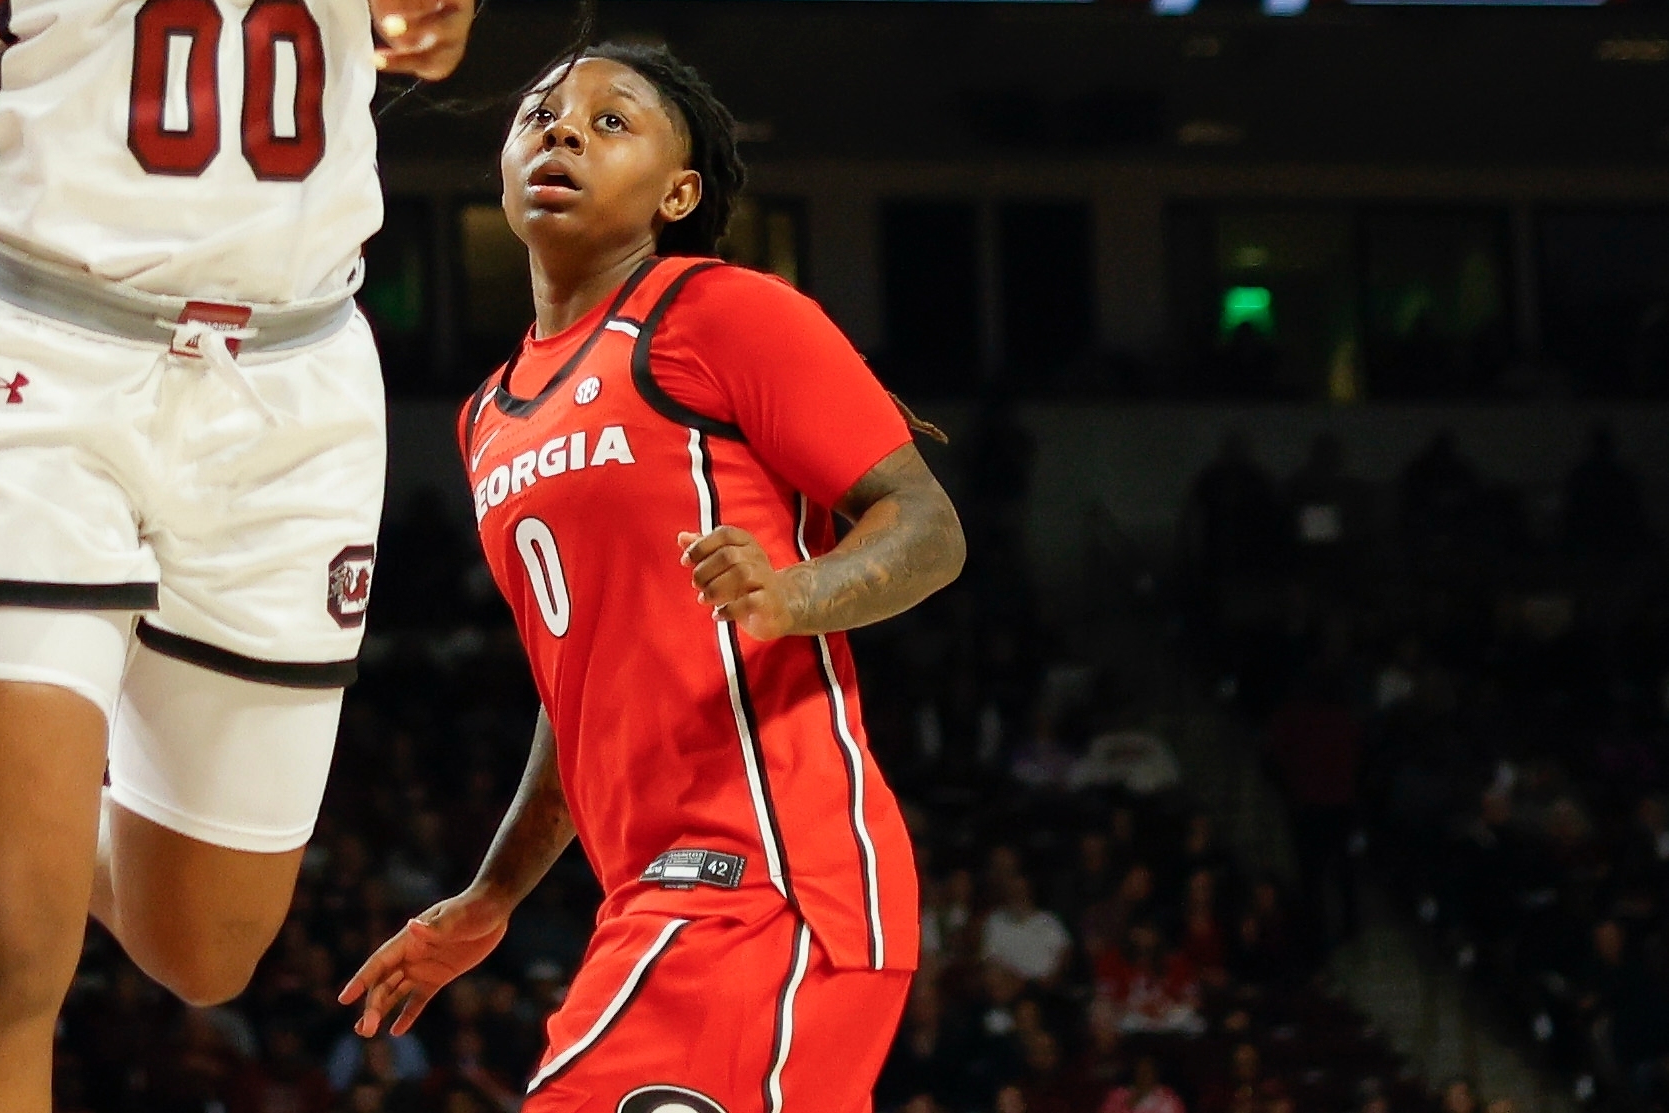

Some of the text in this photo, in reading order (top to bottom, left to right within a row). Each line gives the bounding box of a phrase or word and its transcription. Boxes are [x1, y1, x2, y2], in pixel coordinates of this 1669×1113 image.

[474, 425, 636, 531] EORGIA
[515, 517, 571, 637] 0
[707, 860, 728, 877] 42
